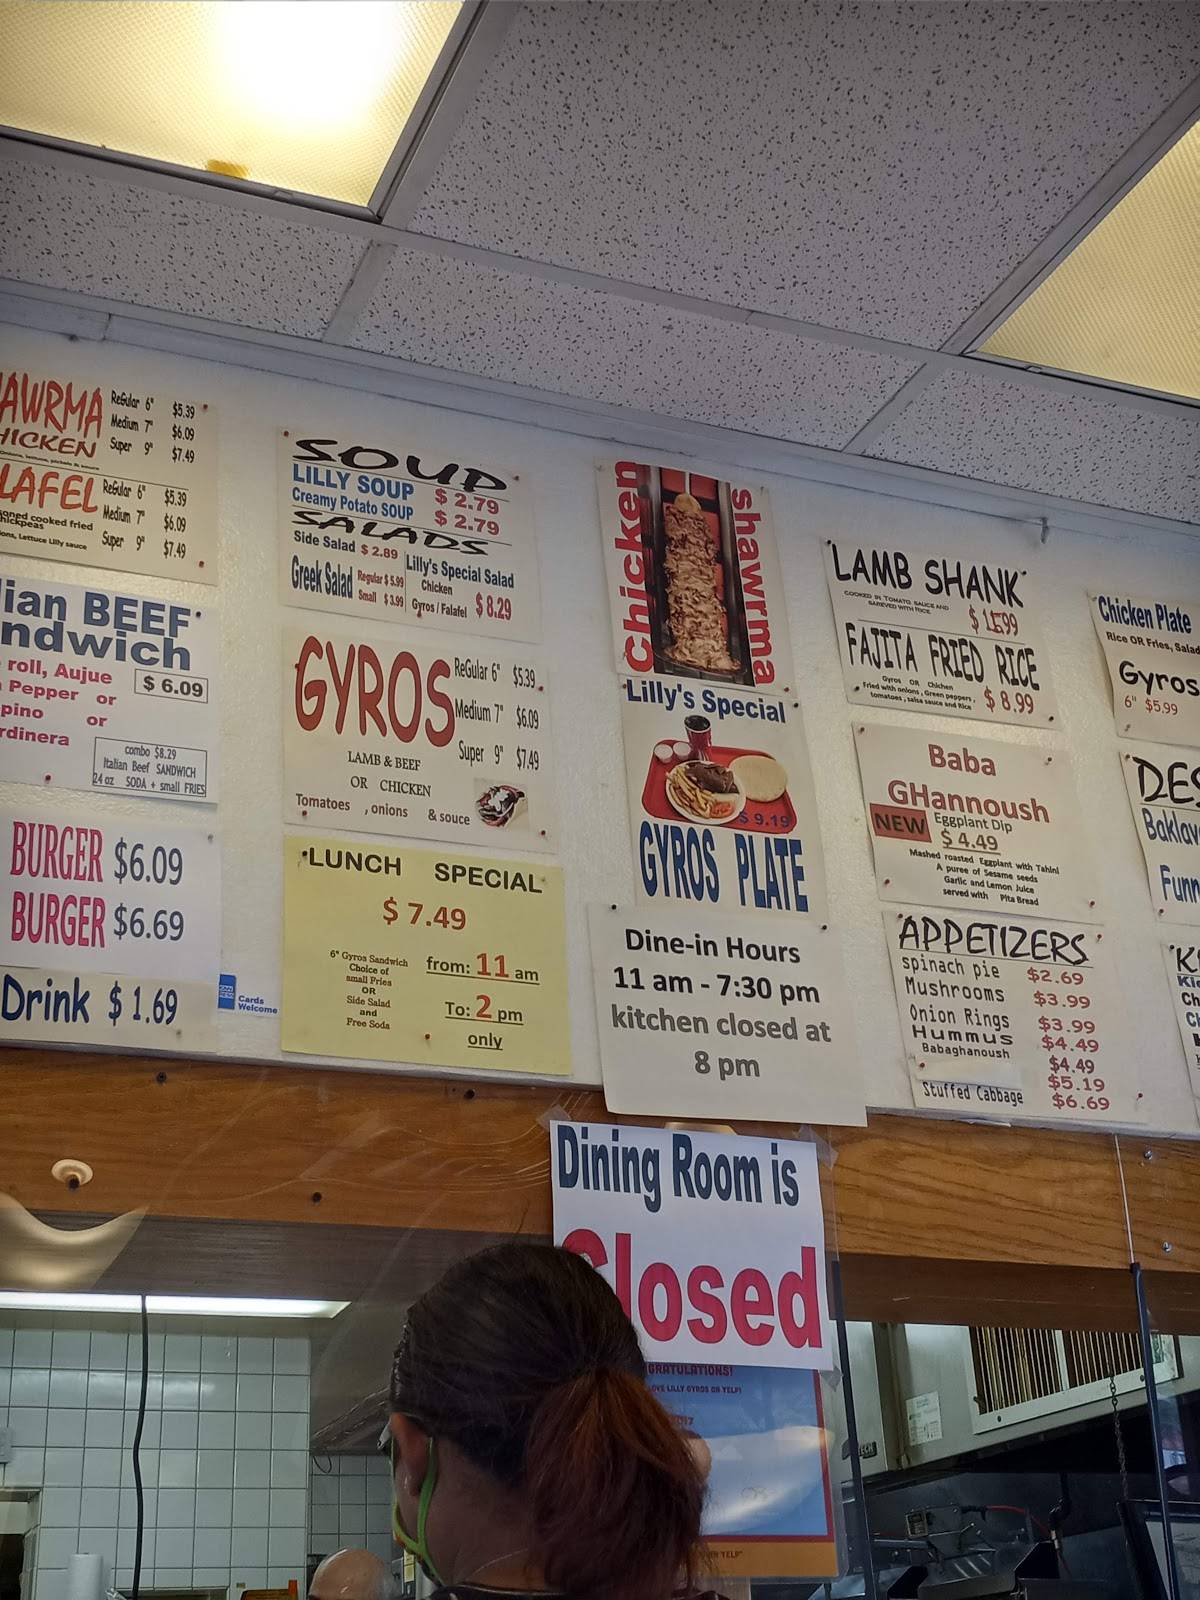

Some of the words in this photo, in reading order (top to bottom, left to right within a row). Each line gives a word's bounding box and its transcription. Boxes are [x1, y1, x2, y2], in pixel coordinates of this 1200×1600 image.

[0, 371, 103, 438] AWRMA
[173, 402, 195, 419] $5.39
[111, 414, 139, 431] Medium
[172, 424, 195, 440] $6.09
[110, 437, 132, 454] Super
[172, 446, 195, 463] $7.49
[0, 463, 98, 513] LAFEL
[165, 488, 187, 506] $5.39
[293, 464, 351, 491] LILLY
[357, 475, 414, 501] SOUP
[103, 505, 130, 522] Medium
[164, 514, 186, 532] $6.09
[292, 487, 337, 510] Creamy
[340, 496, 378, 515] Potato
[381, 505, 414, 521] SOUP
[31, 515, 67, 527] cooked
[70, 520, 94, 531] fried
[291, 510, 489, 556] SALADS
[102, 531, 124, 550] Super
[164, 540, 186, 558] $7.49
[294, 530, 320, 546] Side
[323, 535, 356, 553] Salad
[291, 555, 322, 594] Greek
[325, 561, 353, 599] Salad
[406, 555, 438, 578] Lilly's
[441, 560, 481, 584] Special
[485, 568, 514, 588] Salad
[614, 461, 654, 672] Chicken
[831, 543, 912, 590] LAMB
[924, 559, 1024, 608] SHANK
[421, 580, 453, 596] Chicken
[731, 488, 775, 685] shawrma
[0, 579, 66, 621] ian
[84, 591, 191, 638] BEEF
[440, 602, 468, 618] Falafel
[1098, 595, 1154, 630] Chicken
[1154, 602, 1192, 634] Plate
[1, 621, 191, 671] ndwich
[1106, 632, 1128, 644] Rice
[8, 659, 48, 678] roll,
[54, 663, 112, 684] Aujue
[845, 622, 918, 672] FAJITA
[928, 634, 984, 683] FRIED
[994, 644, 1040, 691] RICE
[295, 636, 456, 748] GYROS
[513, 665, 535, 689] $5.39
[1119, 660, 1200, 699] Gyros
[9, 680, 79, 701] Pepper
[96, 694, 117, 706] or
[626, 679, 695, 711] Lilly's
[702, 688, 786, 723] Special
[1145, 698, 1178, 716] $5.99
[87, 715, 108, 727] or
[455, 698, 490, 722] Medium
[517, 705, 539, 730] $6.09
[103, 757, 128, 772] Italian
[132, 760, 150, 773] Beef
[156, 763, 196, 778] SANDWICH
[125, 745, 150, 758] combo
[155, 747, 176, 760] $8.29
[348, 750, 381, 766] LAMB
[395, 756, 421, 771] BEEF
[459, 740, 484, 766] Super
[517, 746, 539, 771] $7.49
[928, 743, 996, 777] Baba
[126, 776, 147, 789] SODA
[160, 780, 180, 793] small
[350, 776, 368, 790] OR
[379, 779, 431, 798] CHICKEN
[296, 793, 350, 812] Tomatoes
[371, 804, 408, 818] onions
[440, 811, 470, 826] souce
[888, 779, 1051, 824] GHannoush
[874, 812, 925, 836] NEW
[934, 812, 988, 830] Eggplant
[992, 818, 1013, 834] Dip
[1142, 807, 1200, 846] Baklav
[10, 821, 103, 882] BURGER
[114, 837, 183, 886] $6.09
[640, 820, 720, 902] GYROS
[734, 832, 808, 912] PLATE
[910, 848, 941, 860] Mashed
[308, 847, 402, 876] LUNCH
[434, 862, 544, 894] SPECIAL
[946, 864, 969, 876] puree
[984, 869, 1014, 880] Sesame
[986, 881, 1012, 891] Lemon
[943, 888, 970, 898] served
[1016, 896, 1040, 906] Bread
[11, 891, 106, 948] BURGER
[113, 902, 184, 941] $6.69
[625, 928, 718, 958] Dine-in
[727, 937, 801, 964] Hours
[899, 915, 1090, 966] APPETIZERS
[369, 954, 408, 968] Sandwich
[426, 956, 470, 974] from:
[476, 952, 510, 979] 11
[902, 954, 964, 977] spinach
[973, 960, 1000, 980] pie
[1027, 966, 1084, 986] $2.69
[1, 974, 90, 1023] Drink
[239, 996, 264, 1004] Cards
[614, 966, 646, 990] 11
[653, 973, 693, 994] am
[716, 974, 772, 999] 7:30
[780, 982, 820, 1006] pm
[904, 976, 1005, 1002] Mushrooms
[1034, 990, 1090, 1009] $3.99
[238, 1003, 278, 1014] Welcome
[368, 998, 391, 1008] Salad
[445, 1002, 470, 1017] To:
[476, 995, 492, 1019] 2
[910, 1003, 956, 1025] Onion
[964, 1008, 1010, 1032] Rings
[1038, 1016, 1096, 1034] $3.99
[346, 1017, 367, 1028] Free
[369, 1020, 390, 1030] Soda
[612, 1004, 710, 1034] kitchen
[716, 1012, 798, 1040] closed
[806, 1022, 832, 1042] at
[912, 1024, 1014, 1046] Hummus
[1042, 1034, 1099, 1053] $4.49
[468, 1033, 503, 1050] only
[694, 1050, 711, 1075] 8
[718, 1057, 760, 1081] pm
[922, 1042, 1011, 1059] Babaghanoush
[1049, 1054, 1095, 1074] $4.49
[922, 1082, 971, 1100] Stuffed
[976, 1086, 1024, 1108] Cabbage
[1048, 1074, 1104, 1092] $5.19
[1052, 1092, 1110, 1110] $6.69
[557, 1124, 662, 1213] Dining
[672, 1132, 762, 1203] Room
[770, 1142, 800, 1207] is
